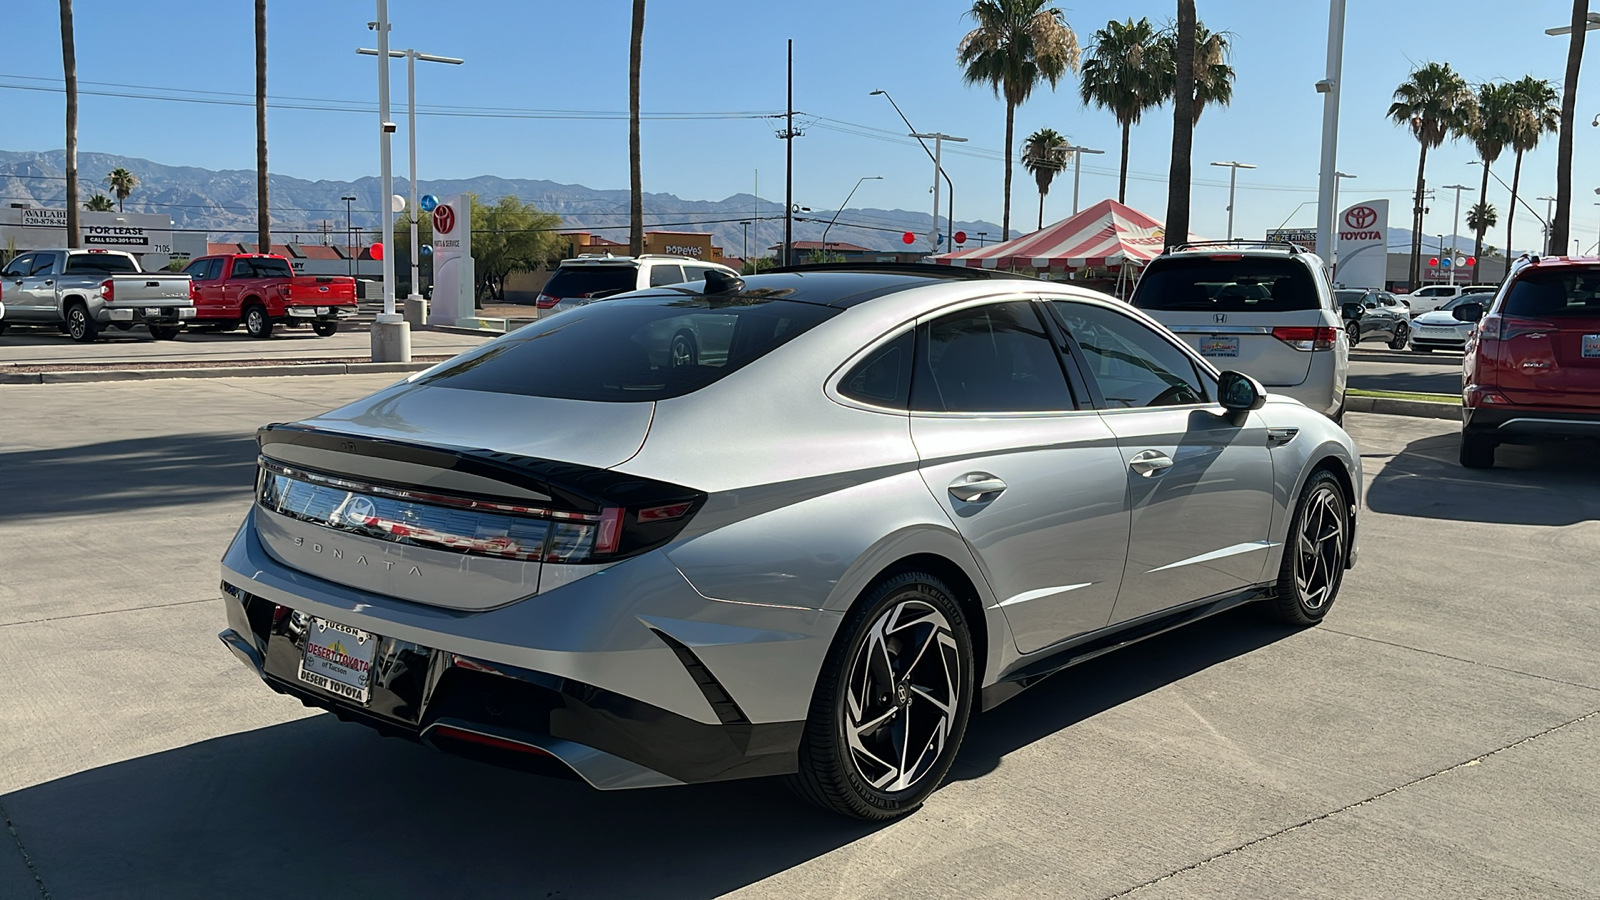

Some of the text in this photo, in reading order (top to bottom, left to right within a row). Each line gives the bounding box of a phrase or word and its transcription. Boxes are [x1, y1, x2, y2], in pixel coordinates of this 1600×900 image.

[89, 226, 144, 236] FOR LEASE
[1339, 231, 1382, 241] TOYOTA
[154, 244, 171, 253] 7105
[294, 537, 422, 576] SONATA
[930, 588, 961, 623] MICHELIN
[325, 620, 359, 636] TUCSON
[307, 642, 370, 673] DESERT TOYOTA
[328, 662, 347, 675] Tucson
[301, 670, 362, 700] DESERT TOYOTA
